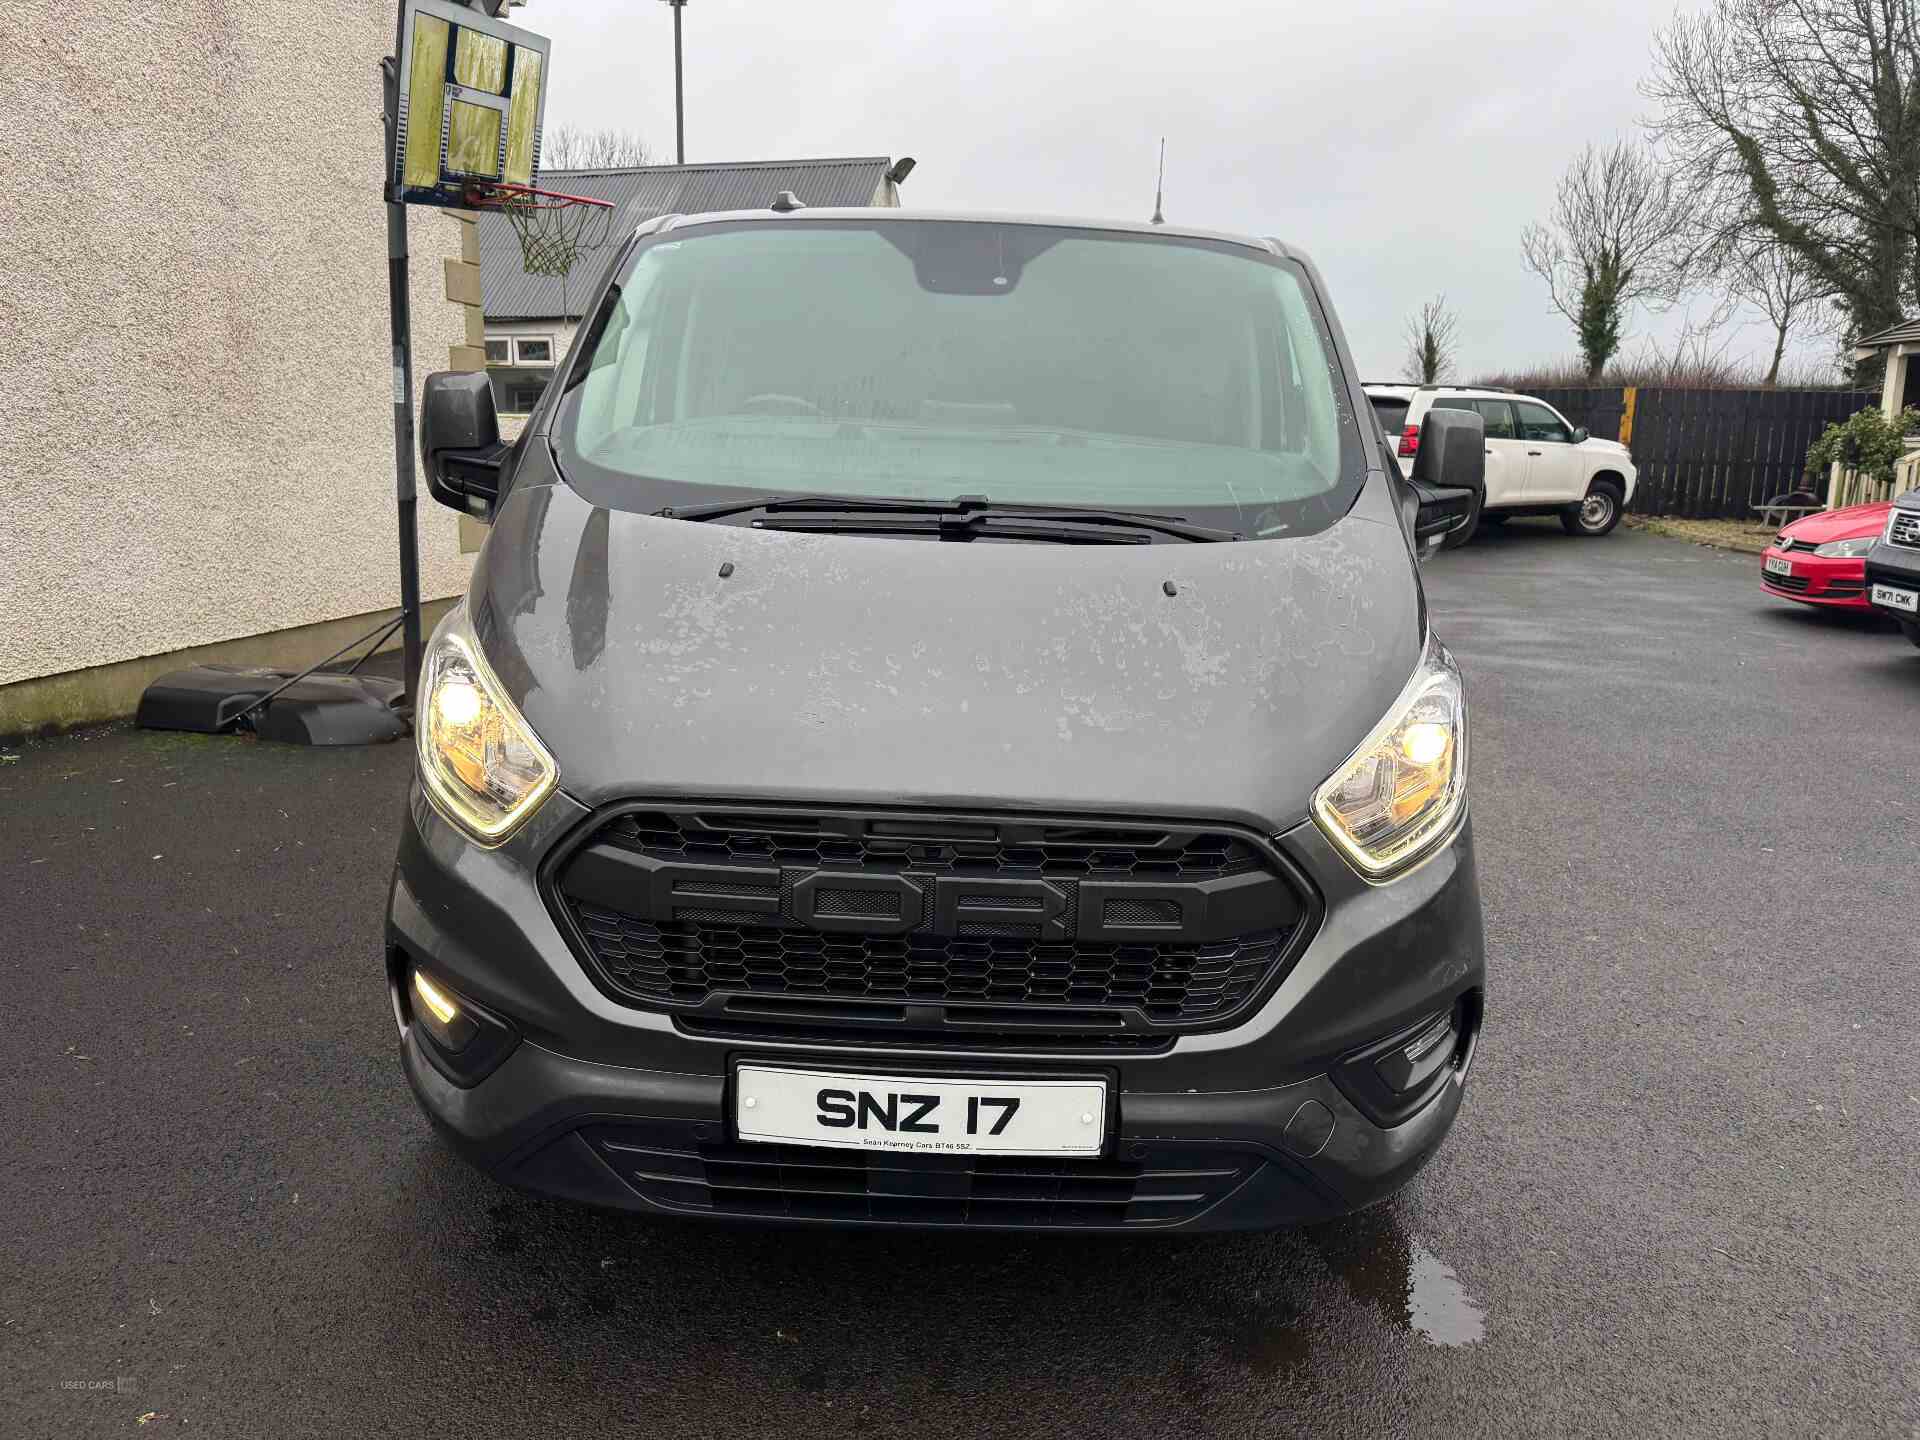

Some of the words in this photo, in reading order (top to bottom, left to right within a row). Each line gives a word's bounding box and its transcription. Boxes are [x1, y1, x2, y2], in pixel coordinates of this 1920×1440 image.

[664, 864, 1192, 943] FORD
[816, 1088, 941, 1134] SNZ
[966, 1096, 1020, 1136] 17
